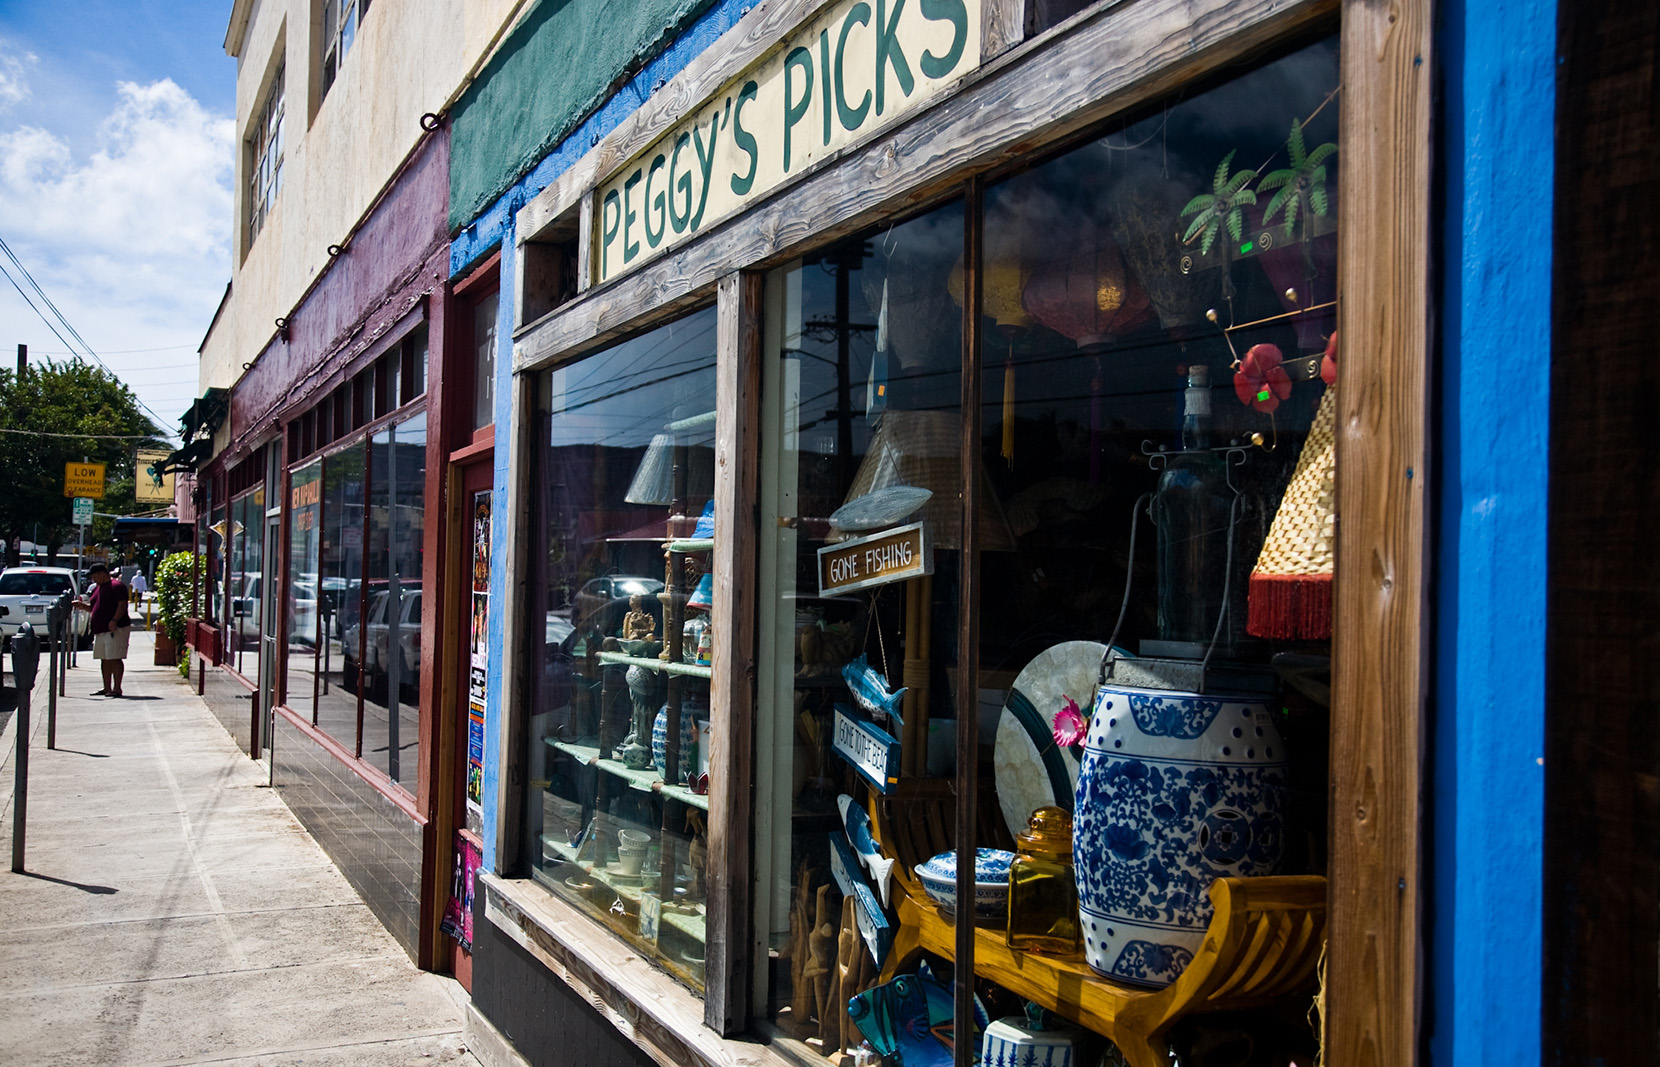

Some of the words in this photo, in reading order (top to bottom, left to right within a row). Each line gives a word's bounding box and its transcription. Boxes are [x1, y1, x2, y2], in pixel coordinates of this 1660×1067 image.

[602, 80, 758, 281] PEGGY'S
[783, 0, 968, 174] PICKS
[67, 486, 101, 494] CLEARANCE
[74, 468, 97, 477] LOW
[830, 553, 859, 583] GONE
[865, 541, 912, 574] FISHING
[840, 719, 854, 749] GONE
[855, 729, 861, 755] TO
[861, 734, 872, 763] THE
